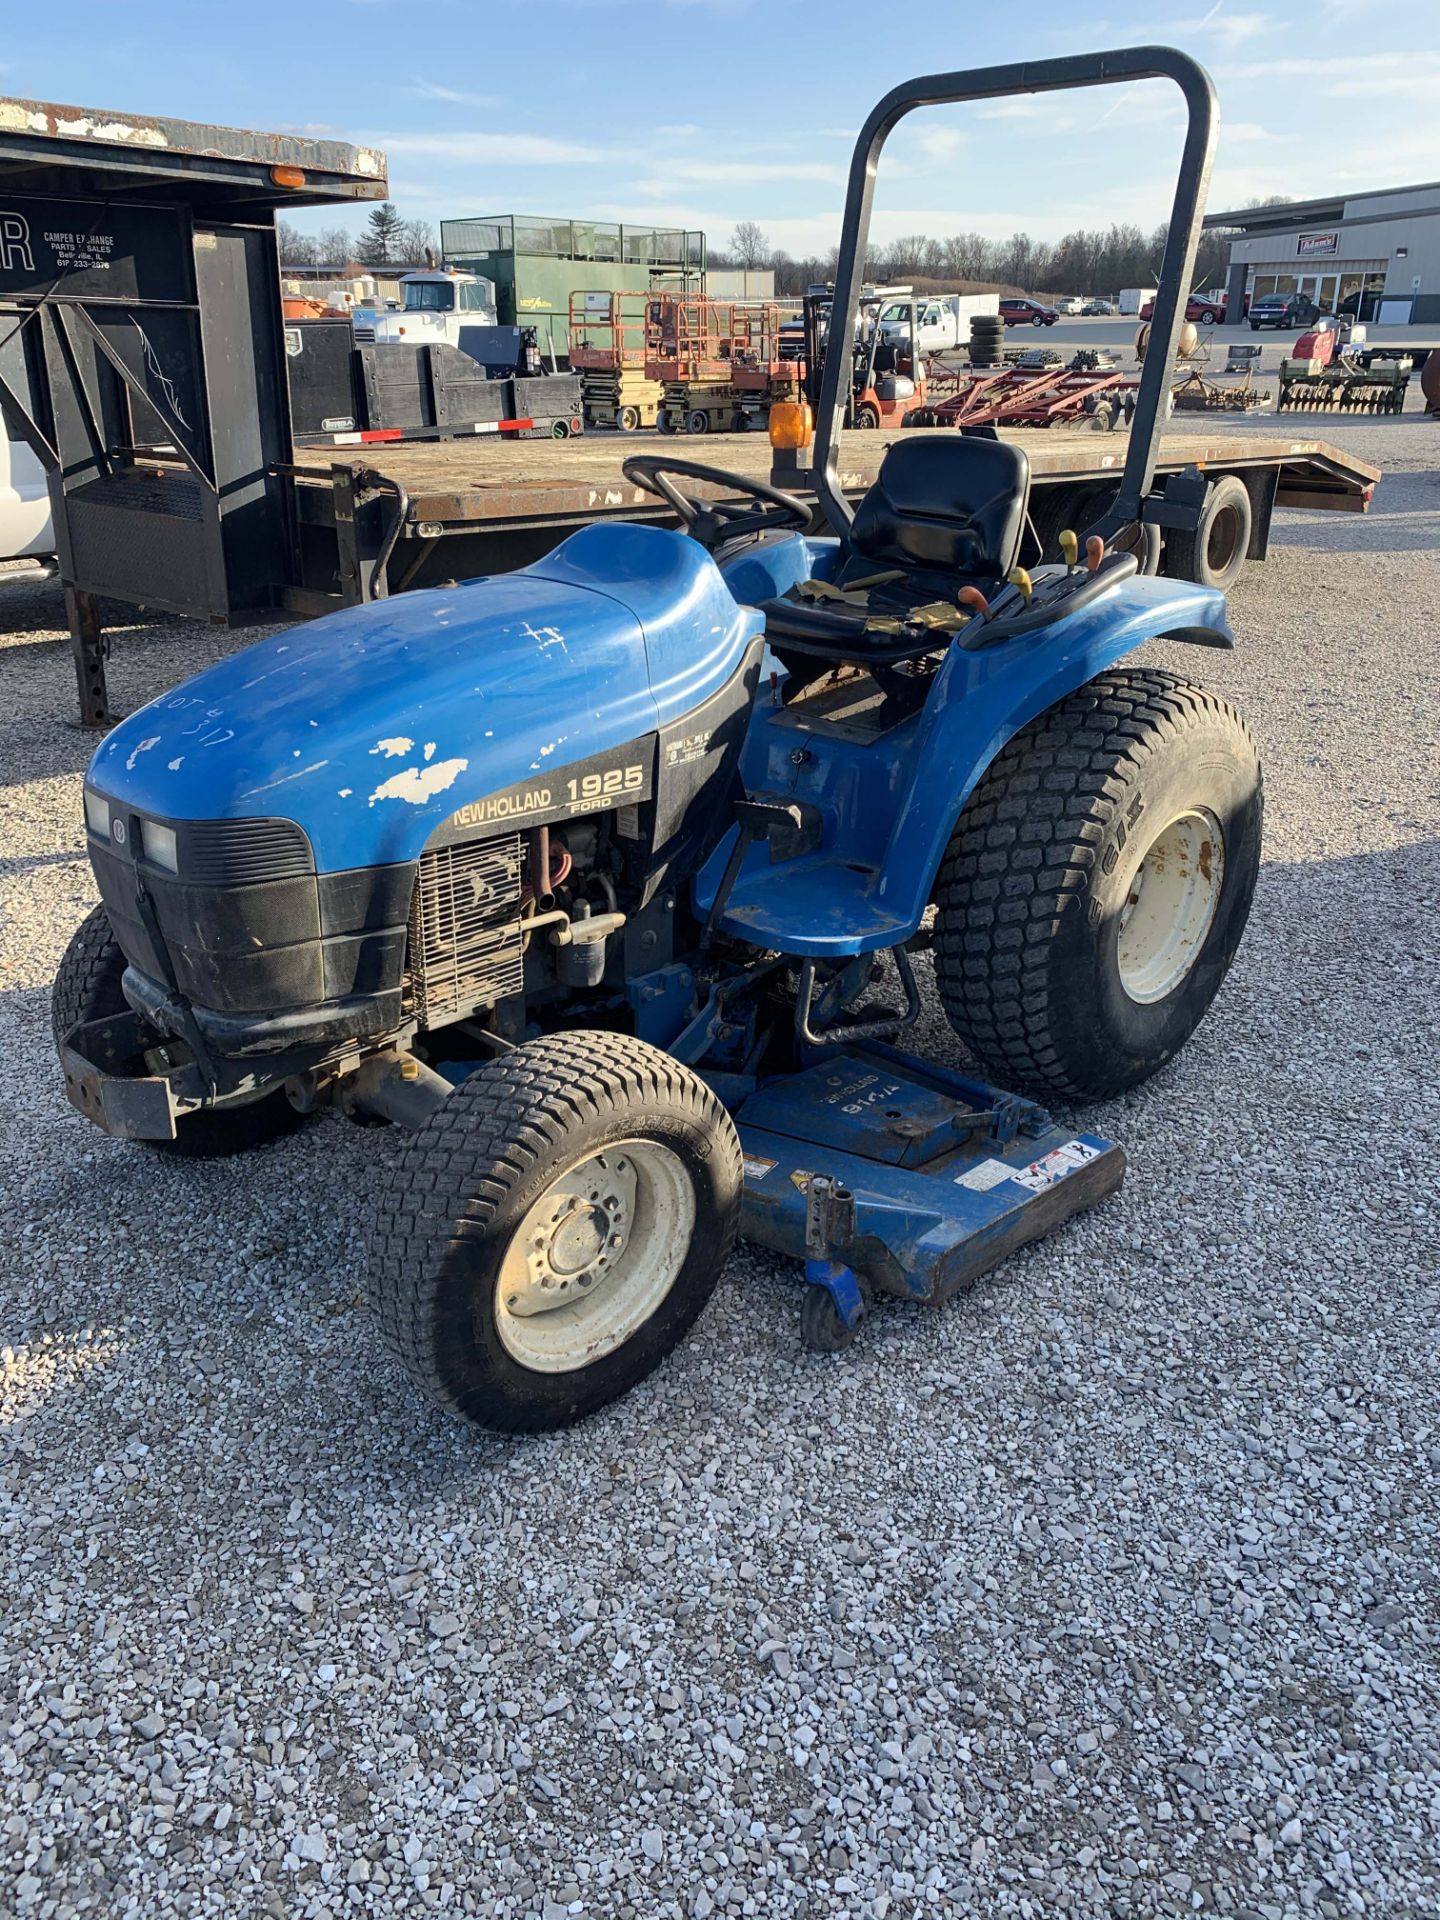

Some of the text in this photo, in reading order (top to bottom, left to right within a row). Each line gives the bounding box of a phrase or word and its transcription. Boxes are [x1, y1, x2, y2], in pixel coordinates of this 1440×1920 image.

[44, 232, 114, 246] CAMPER EXHANGE
[51, 243, 75, 251] PARTS
[87, 245, 111, 253] SALES
[454, 764, 643, 826] NEW HOLLAND 1925
[571, 797, 612, 814] FORD
